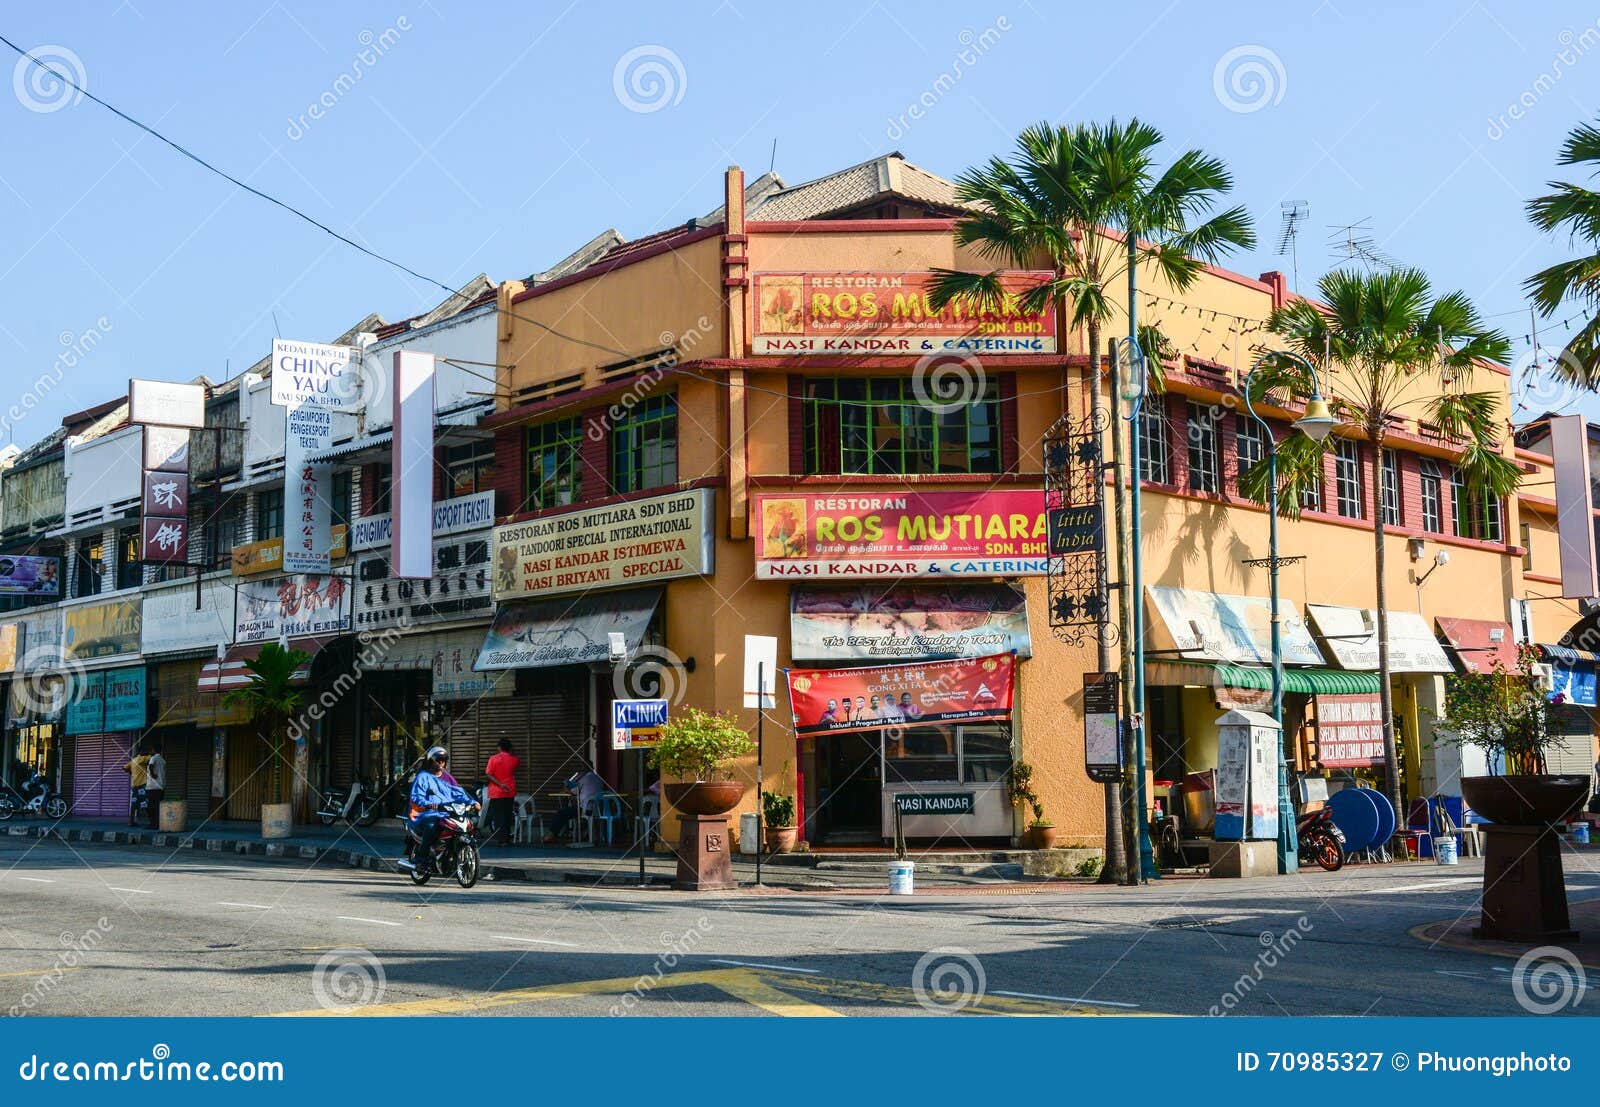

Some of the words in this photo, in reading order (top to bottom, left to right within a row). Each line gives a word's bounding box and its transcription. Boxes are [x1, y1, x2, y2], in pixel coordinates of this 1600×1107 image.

[811, 277, 903, 288] RESTORAN
[812, 292, 879, 318] ROS
[978, 322, 1010, 333] SDN.
[1014, 323, 1047, 333] BHD.
[277, 344, 307, 354] KEDAI
[766, 339, 815, 351] NASI
[824, 339, 910, 351] KANDAR
[920, 339, 935, 350] &
[943, 339, 1043, 350] CATERING
[280, 356, 342, 378] CHING
[293, 376, 329, 394] YAU
[295, 394, 319, 404] SDN.
[320, 397, 343, 407] BHD.
[290, 409, 326, 424] PENGIMPORT
[290, 423, 330, 437] PENGEKSPORT
[299, 437, 319, 449] TEKSTIL
[814, 498, 907, 510] RESTORAN
[355, 517, 392, 544] PENGIMPO
[433, 503, 462, 530] KSPORT
[463, 498, 491, 523] TEKSTIL
[499, 521, 555, 543] RESTORAN
[557, 518, 580, 533] ROS
[582, 508, 637, 528] MUTIARA
[640, 503, 665, 518] SDN
[668, 497, 695, 513] BHD
[1057, 512, 1094, 528] Little
[815, 515, 884, 542] ROS
[897, 513, 1047, 541] MUTIARA
[520, 541, 566, 557] TANDOORI
[566, 532, 606, 550] SPECIAL
[610, 518, 692, 542] INTERNATIONAL
[1056, 532, 1094, 548] India
[985, 543, 1018, 554] SDN.
[524, 558, 552, 575] NASI
[555, 549, 609, 569] KANDAR
[613, 538, 686, 560] ISTIMEWA
[524, 575, 553, 591] NASI
[557, 568, 610, 588] BRIYANI
[622, 558, 684, 578] SPECIAL
[770, 564, 819, 576] NASI
[828, 563, 919, 575] KANDAR
[928, 562, 941, 573] &
[239, 622, 261, 633] DRAGON
[262, 620, 275, 630] BALL
[822, 636, 844, 647] The
[847, 635, 881, 647] BEST
[881, 635, 909, 646] Nasi
[911, 634, 954, 646] Kandar
[956, 634, 969, 645] in
[971, 633, 1005, 645] TOWN
[109, 681, 140, 699] JEWELS
[867, 684, 896, 692] GONG
[617, 704, 664, 724] KLINIK
[617, 732, 627, 743] 24
[898, 798, 923, 810] NASI
[925, 797, 969, 810] KANDAR
